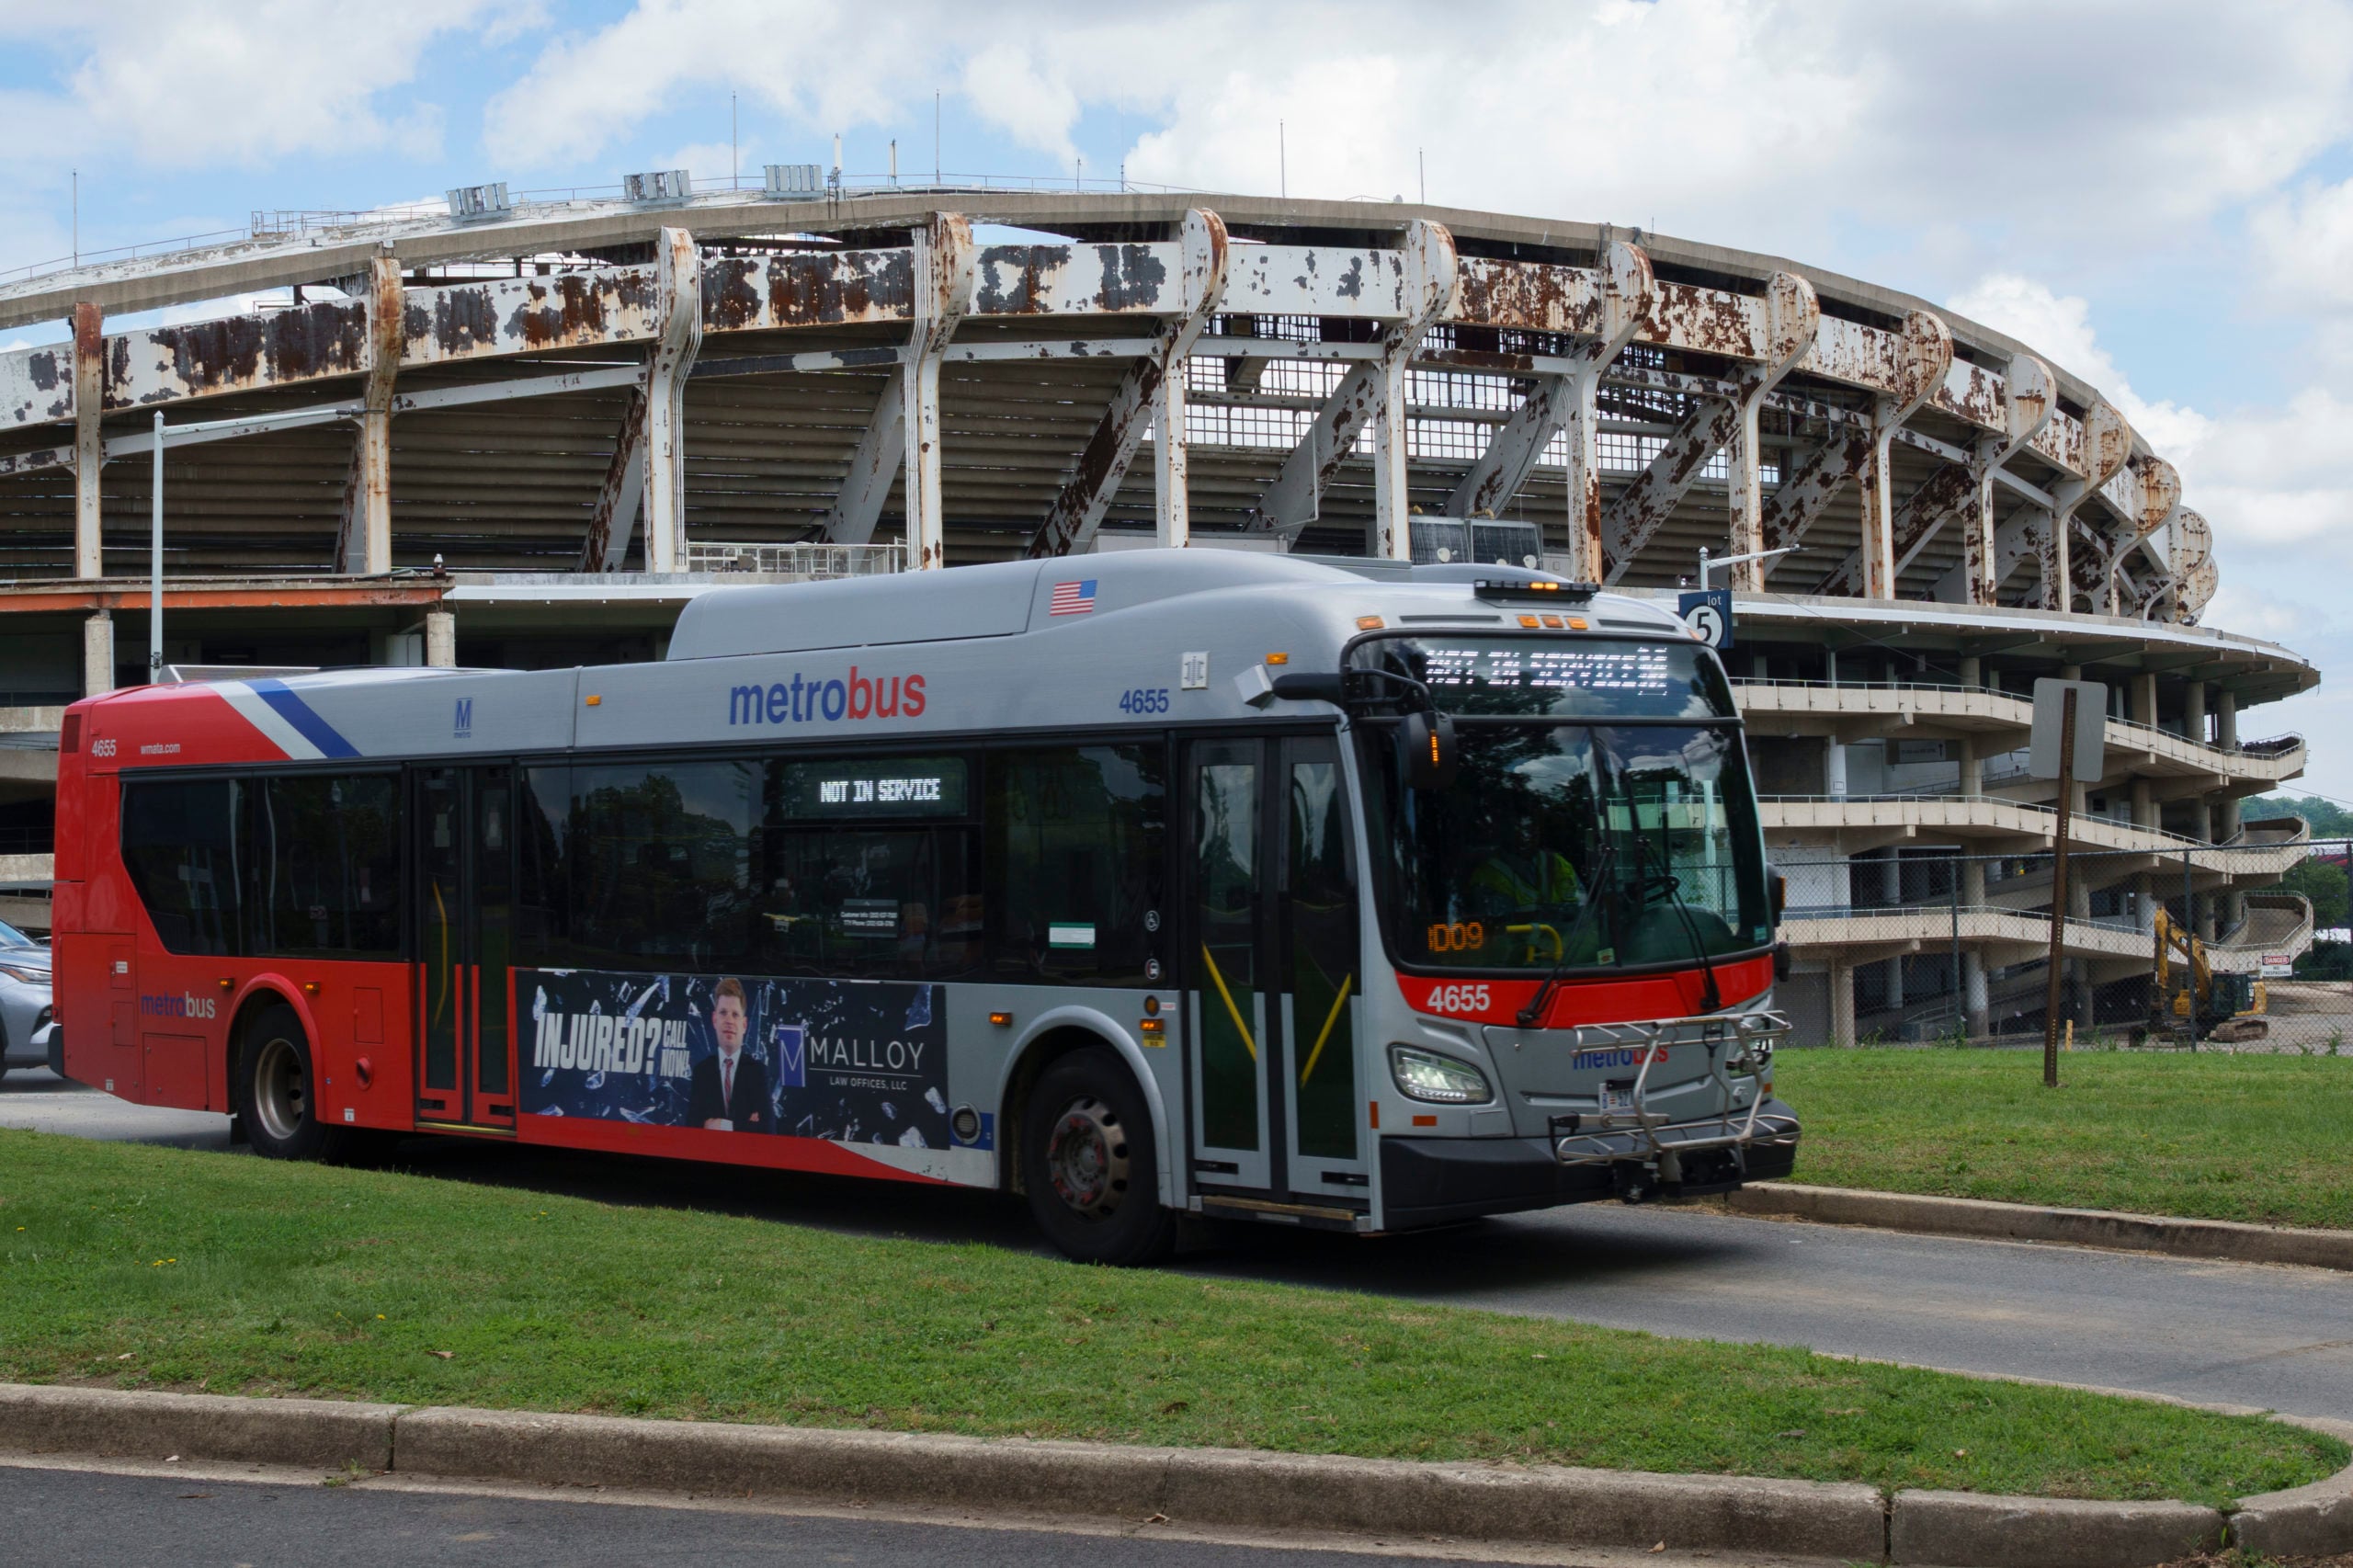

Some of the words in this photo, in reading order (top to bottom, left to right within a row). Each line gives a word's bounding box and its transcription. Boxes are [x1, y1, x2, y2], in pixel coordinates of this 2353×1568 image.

[1707, 595, 1722, 607] lot
[1697, 611, 1712, 642] 5
[1426, 650, 1479, 685] NOT
[1487, 652, 1520, 686] IN
[729, 665, 926, 725] metrobus
[1119, 688, 1169, 714] 4655
[91, 739, 117, 757] 4655
[141, 743, 181, 755] wmata.com
[820, 781, 848, 802] NOT
[853, 780, 873, 801] IN
[878, 778, 941, 801] SERVICE
[140, 991, 216, 1019] metrobus
[1427, 984, 1491, 1013] 4655
[533, 1012, 662, 1075] INJURED?
[663, 1020, 688, 1049] CALL
[810, 1036, 925, 1071] MALLOY
[1573, 1047, 1670, 1070] metrobs
[829, 1076, 848, 1086] LAW
[850, 1077, 889, 1090] OFFICES,
[891, 1080, 908, 1091] LLC
